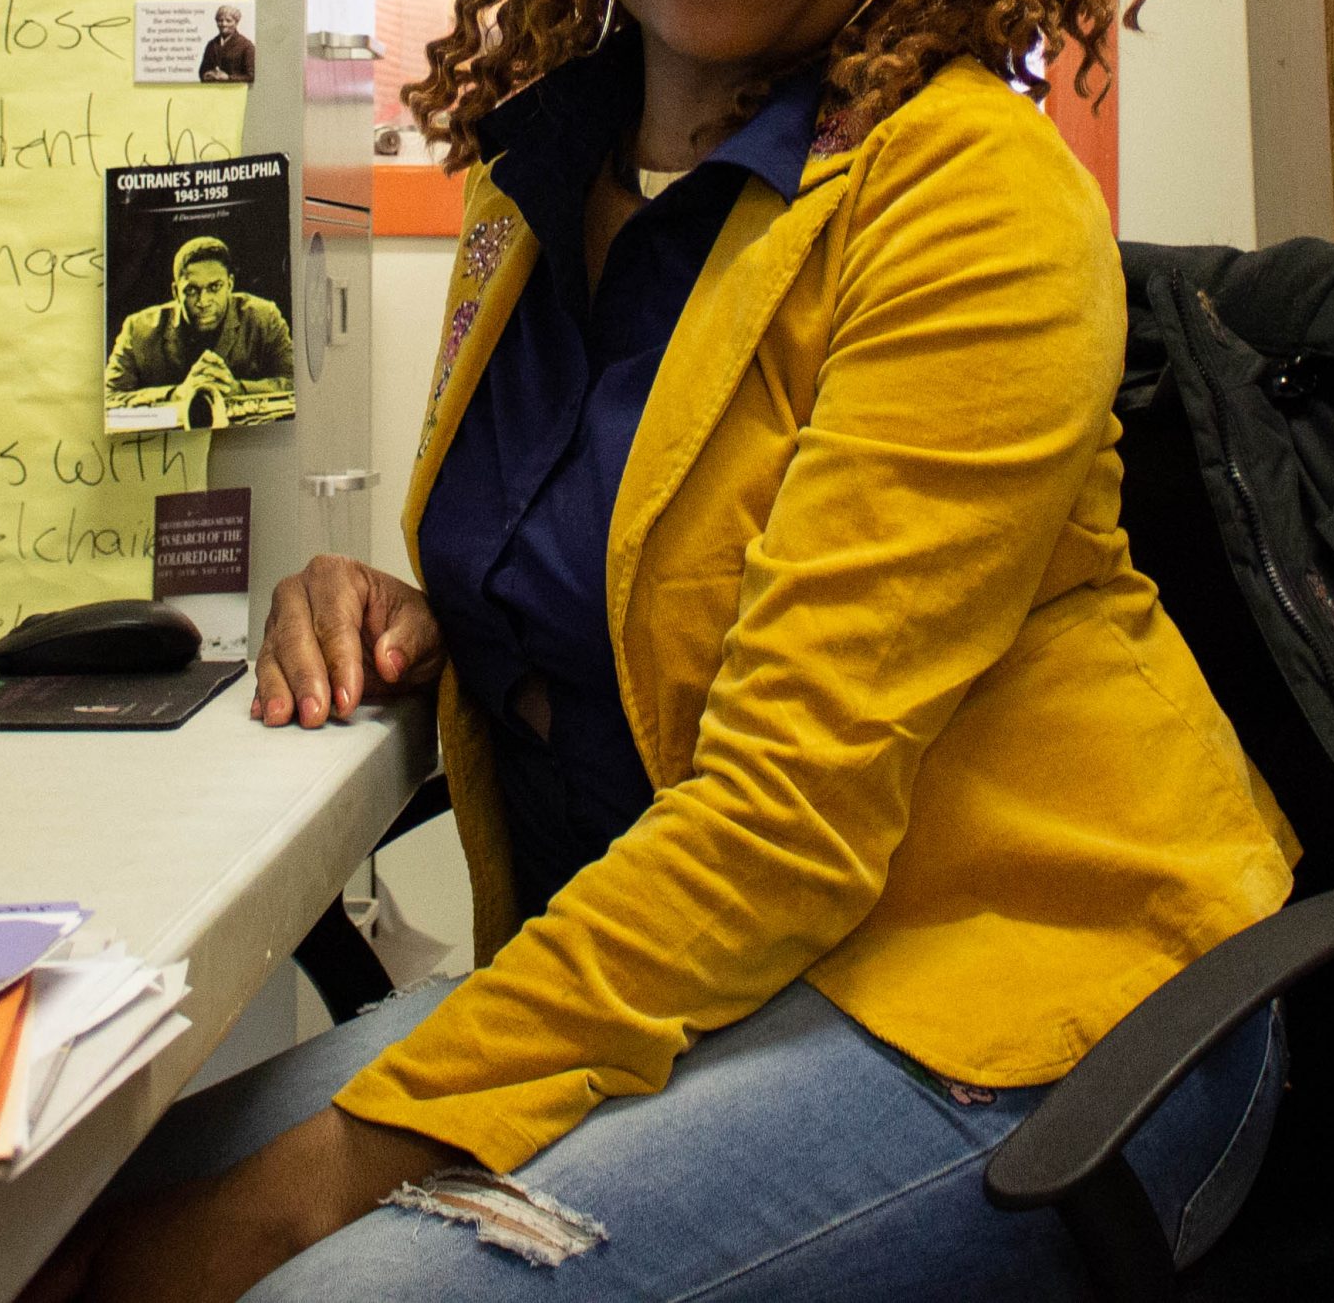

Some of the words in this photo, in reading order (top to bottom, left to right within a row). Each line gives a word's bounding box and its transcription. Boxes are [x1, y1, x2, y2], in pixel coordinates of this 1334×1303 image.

[125, 97, 232, 168] who
[117, 170, 192, 191] COLTRANE'S
[195, 160, 281, 186] PHILADELPHIA
[174, 185, 228, 203] 1943-1958
[54, 431, 188, 491] with
[171, 531, 206, 546] SEARCH
[207, 530, 221, 544] OF
[222, 529, 243, 543] THE
[157, 550, 208, 567] COLORED
